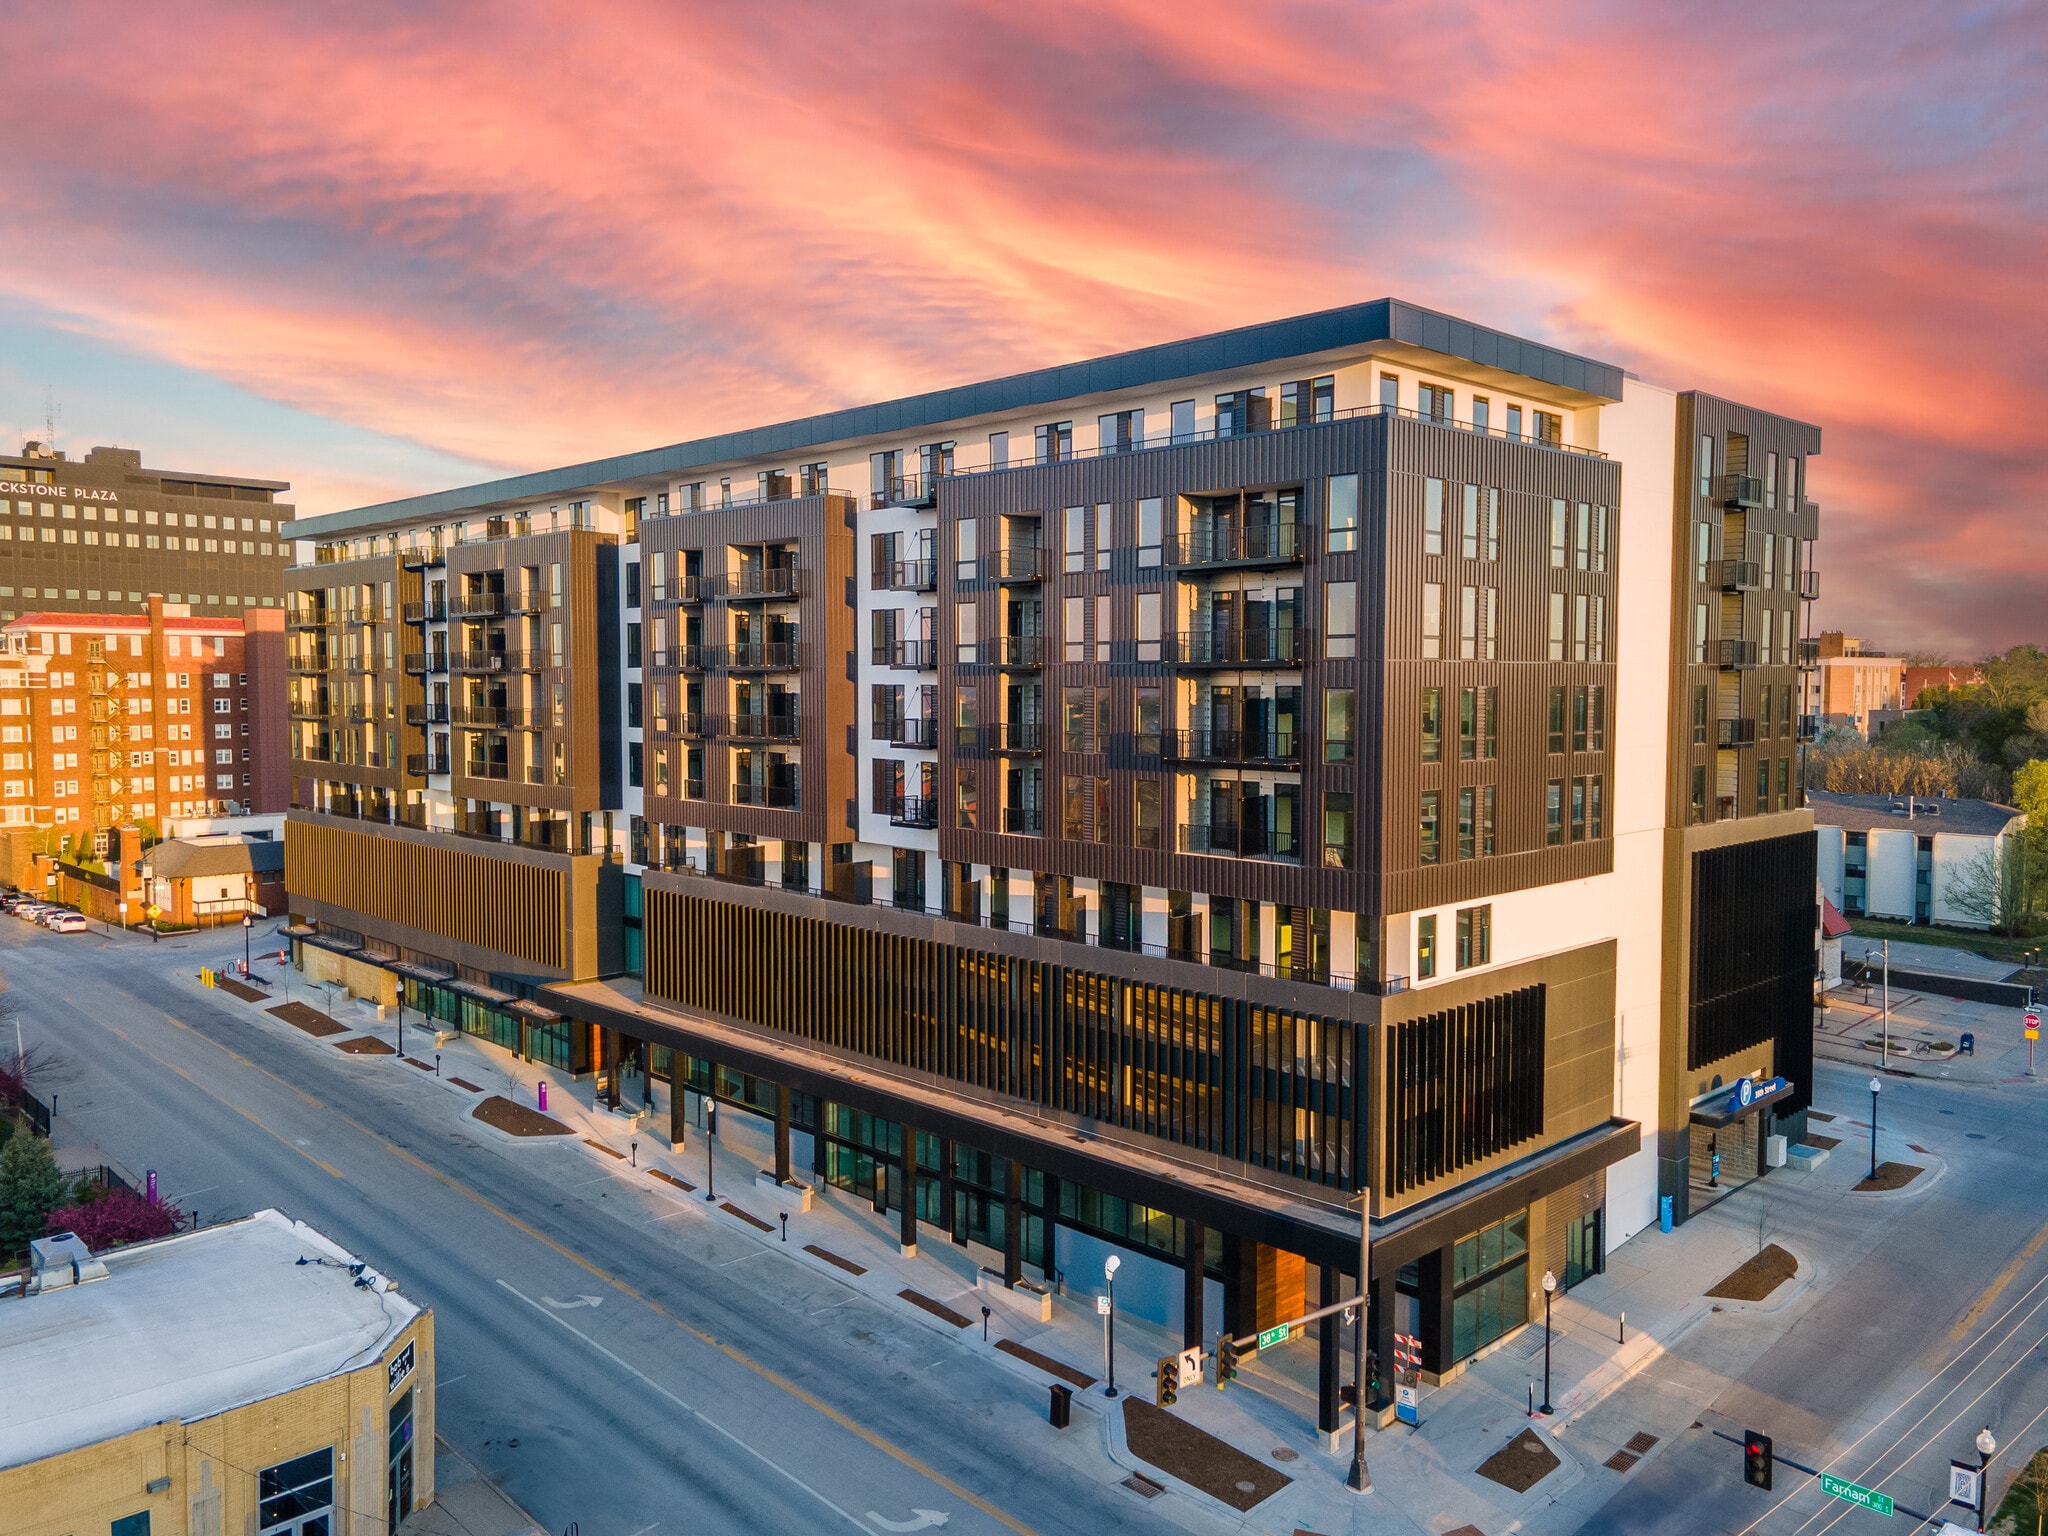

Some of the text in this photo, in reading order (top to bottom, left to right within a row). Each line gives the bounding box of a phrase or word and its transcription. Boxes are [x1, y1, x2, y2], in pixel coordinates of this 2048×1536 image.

[75, 488, 118, 501] PLAZA
[1764, 1082, 1777, 1095] Street
[1278, 1327, 1287, 1338] St
[390, 1356, 402, 1376] bob
[1183, 1373, 1196, 1384] ONLY
[1825, 1478, 1870, 1504] Farnam
[1877, 1495, 1884, 1503] St
